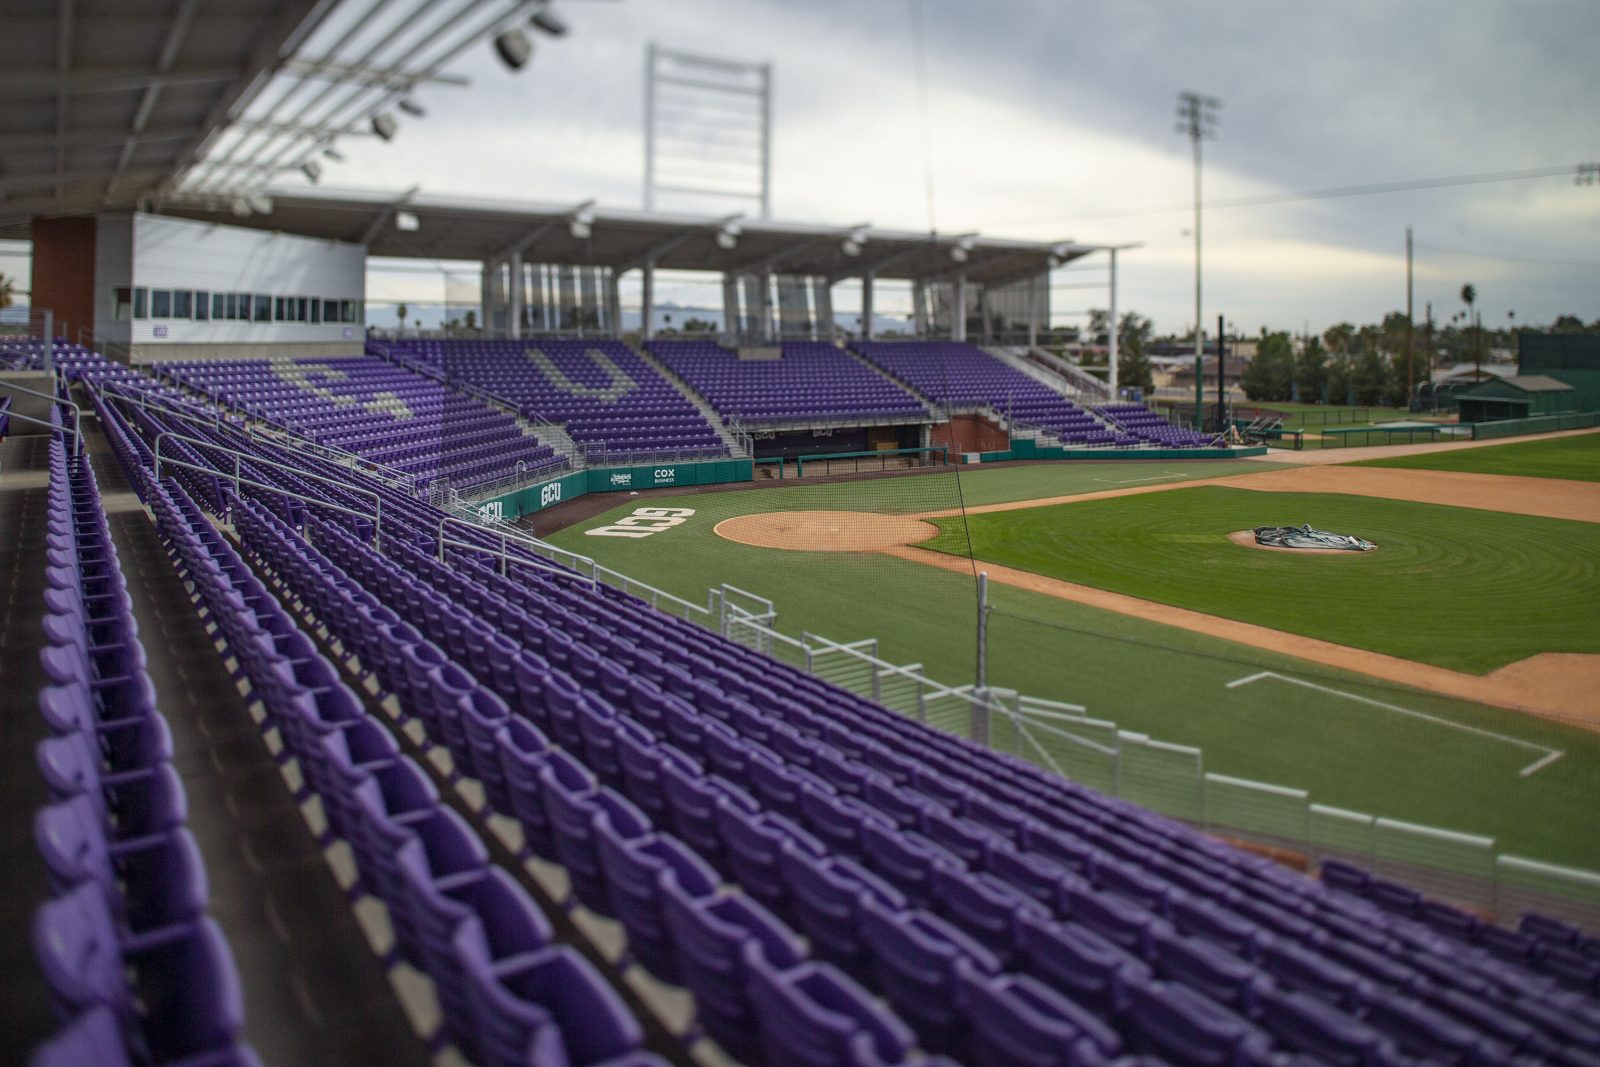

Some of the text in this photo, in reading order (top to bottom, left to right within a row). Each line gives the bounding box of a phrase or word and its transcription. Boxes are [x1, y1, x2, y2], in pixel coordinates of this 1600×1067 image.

[654, 468, 675, 478] COX
[541, 482, 561, 507] GCU
[583, 507, 696, 539] GCU
